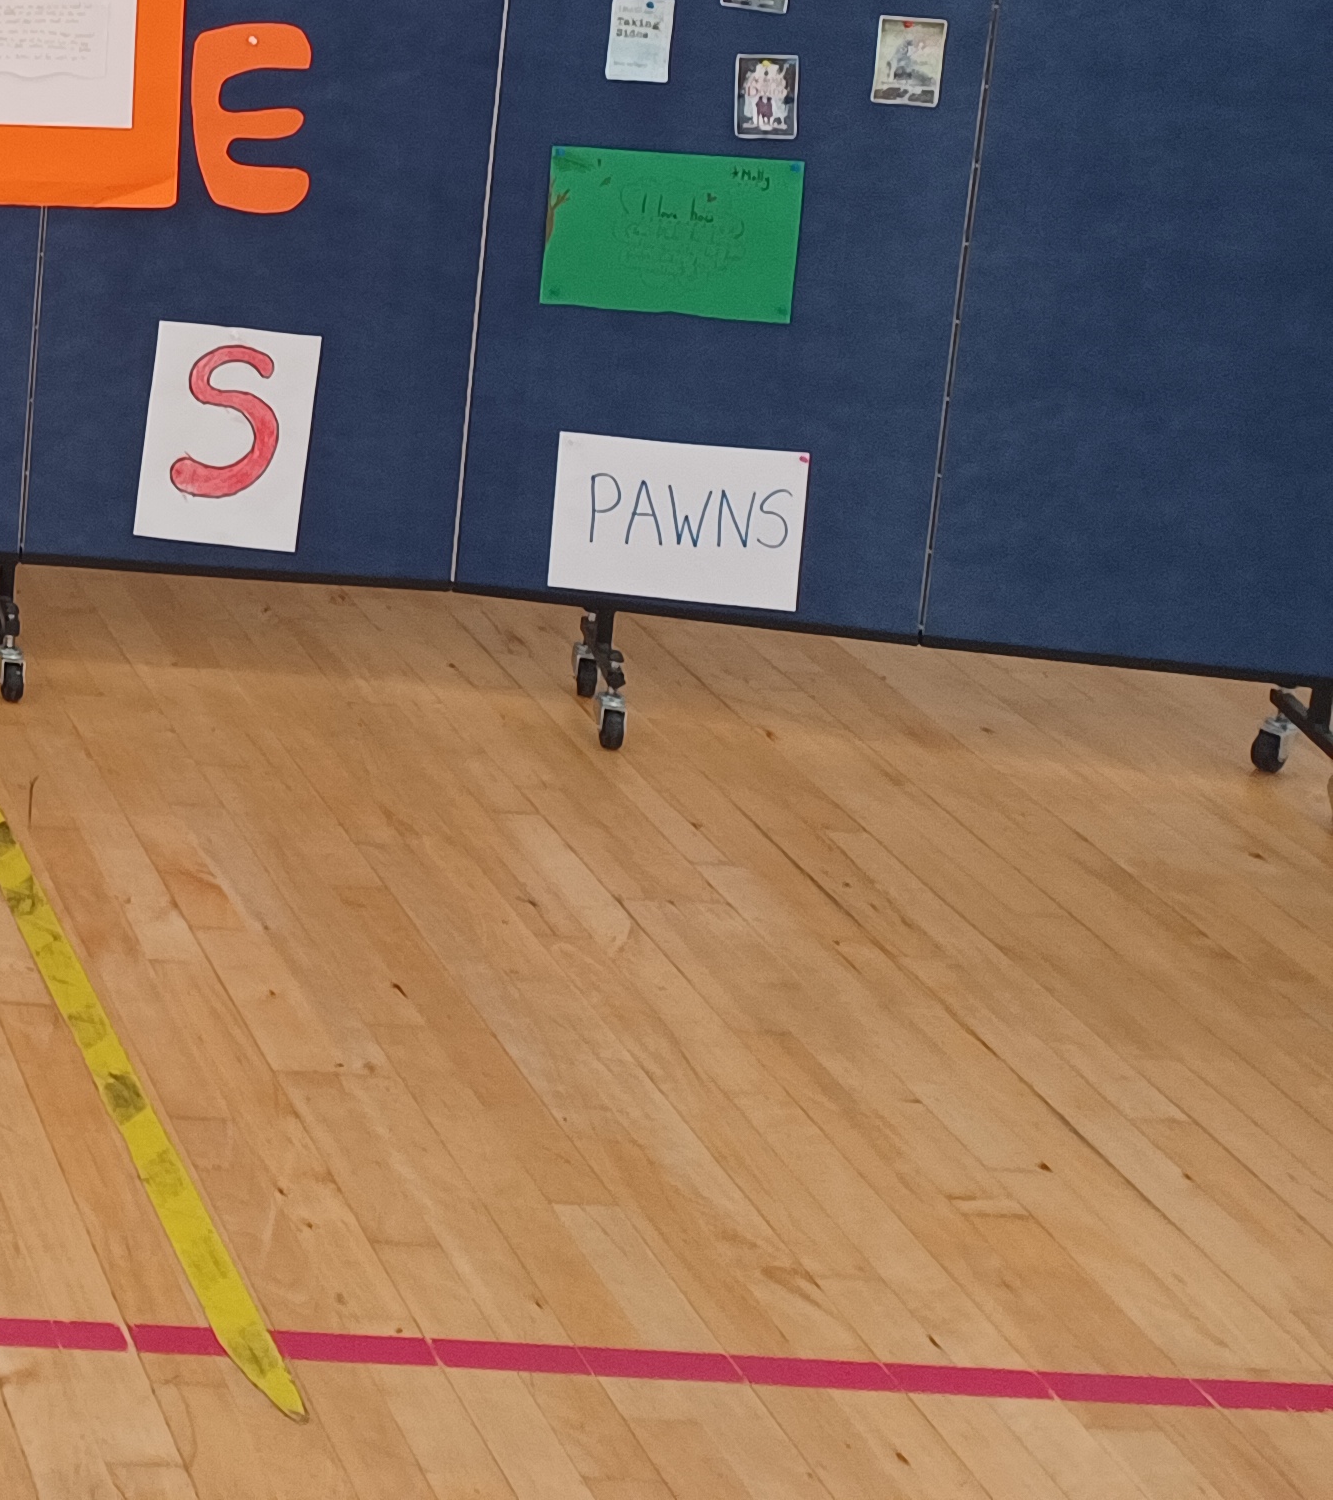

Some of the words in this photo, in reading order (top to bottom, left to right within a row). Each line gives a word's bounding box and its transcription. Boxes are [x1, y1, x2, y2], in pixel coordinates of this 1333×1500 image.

[617, 17, 661, 31] Taking
[616, 28, 649, 39] Sides
[587, 472, 794, 550] PAWNS
